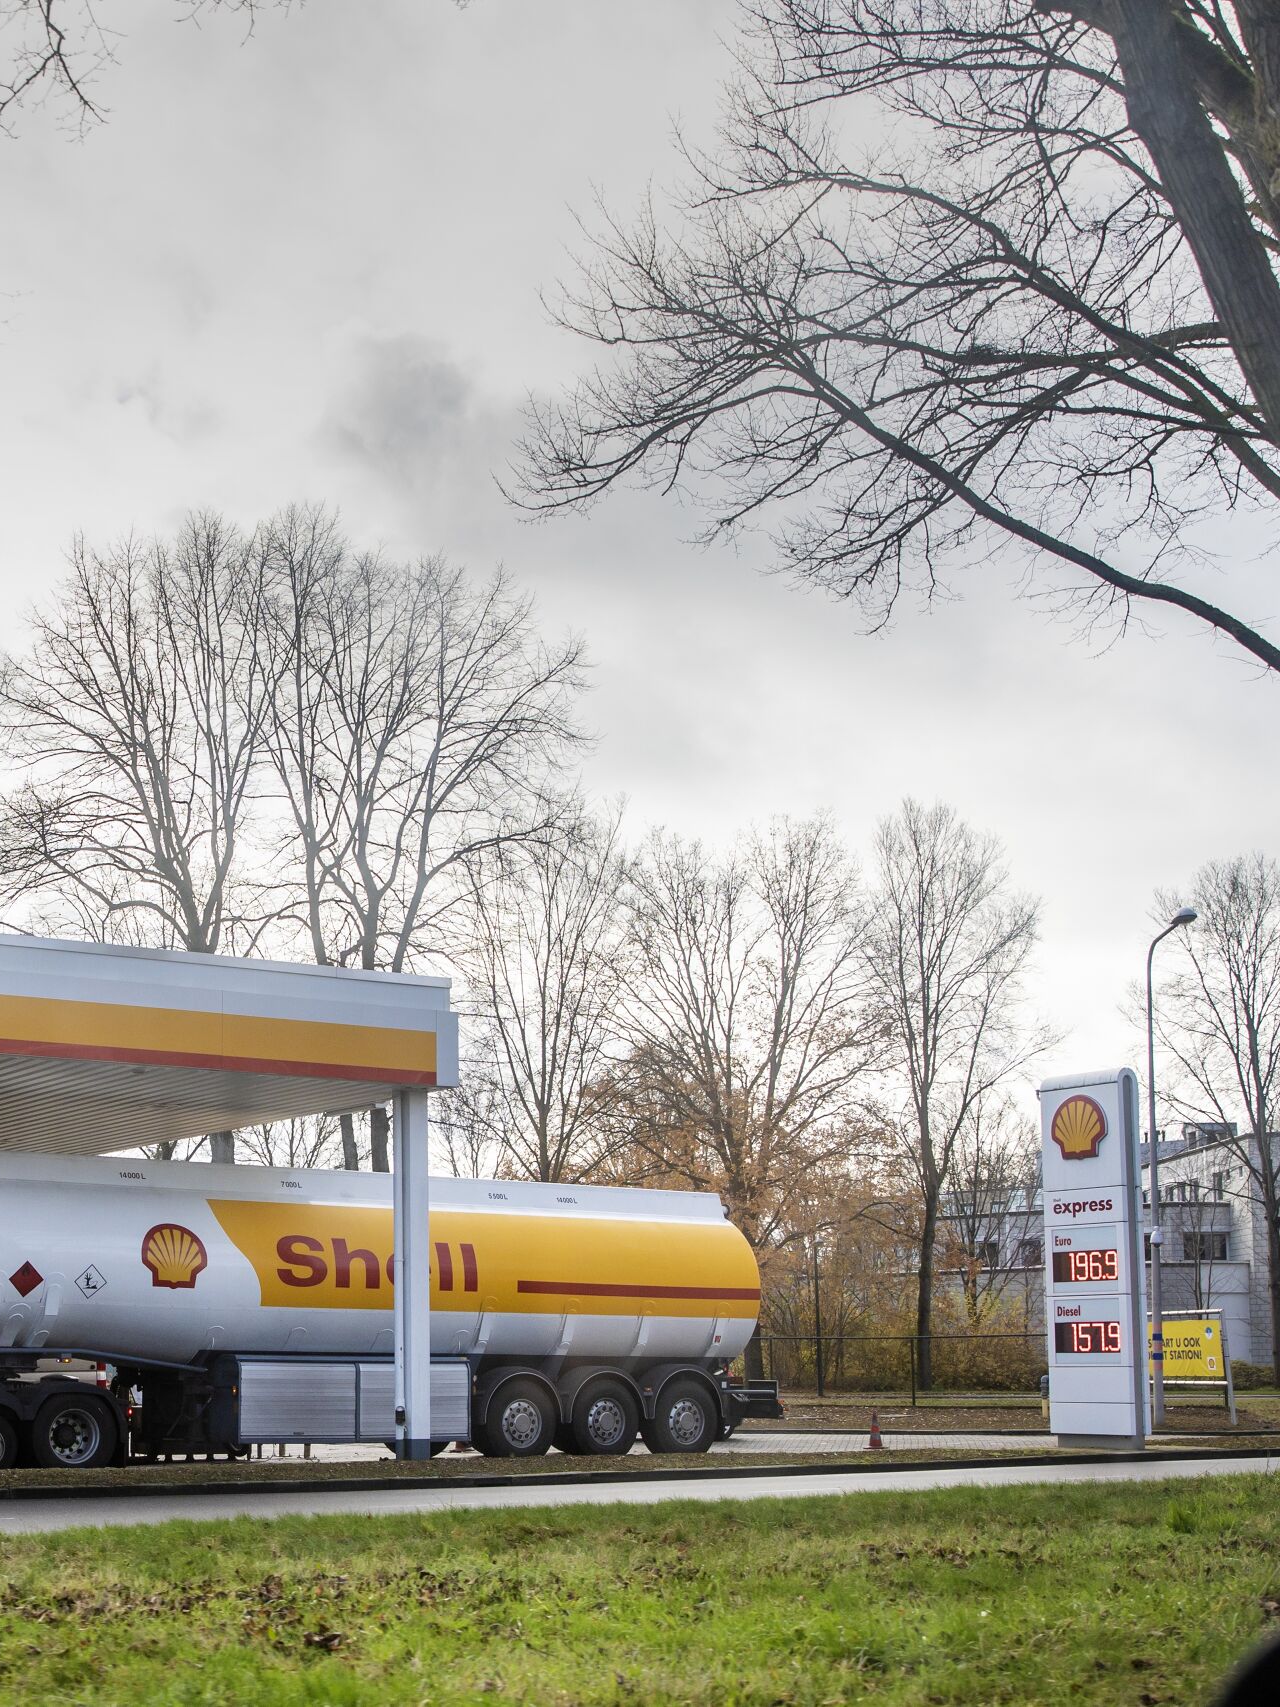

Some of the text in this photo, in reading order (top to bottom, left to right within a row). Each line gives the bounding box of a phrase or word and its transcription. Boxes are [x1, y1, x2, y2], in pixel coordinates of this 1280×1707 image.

[1053, 1199, 1113, 1218] express
[1054, 1235, 1072, 1247] Euro
[276, 1234, 479, 1293] Shll
[1068, 1250, 1119, 1281] 196.9
[1057, 1305, 1081, 1318] Diesel
[1071, 1322, 1121, 1353] 157.9
[1176, 1338, 1181, 1348] U
[1183, 1337, 1201, 1348] OOK
[1169, 1350, 1203, 1360] STATION!
